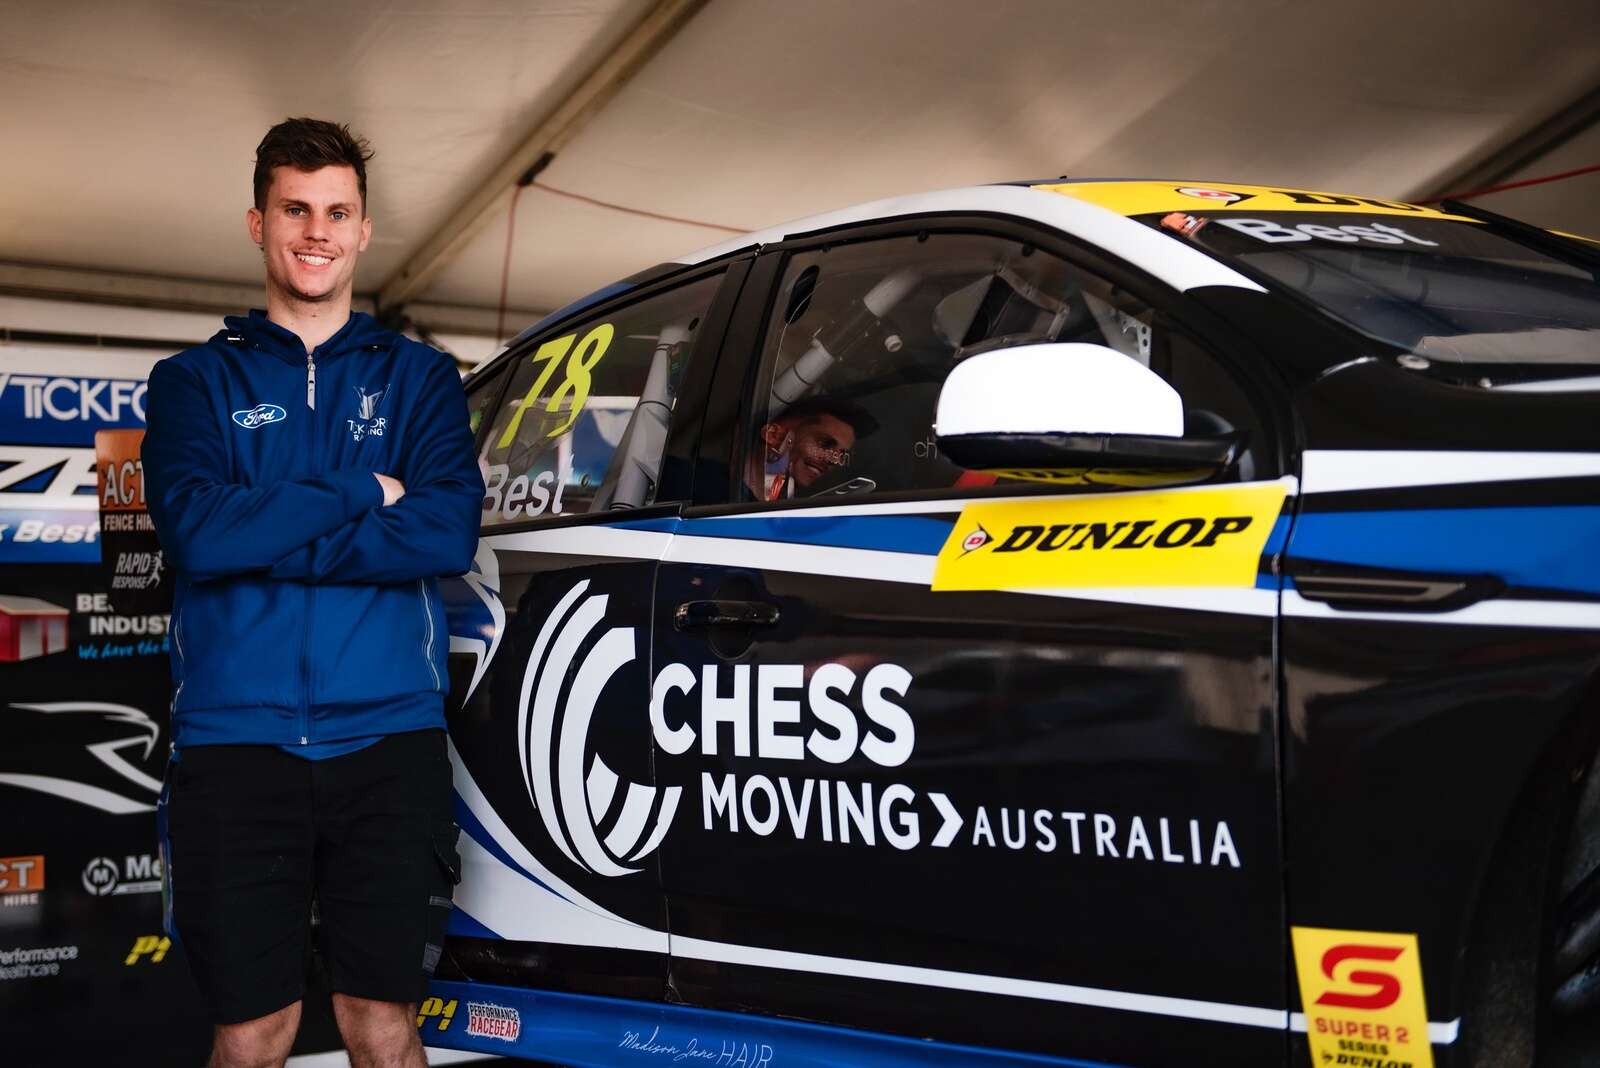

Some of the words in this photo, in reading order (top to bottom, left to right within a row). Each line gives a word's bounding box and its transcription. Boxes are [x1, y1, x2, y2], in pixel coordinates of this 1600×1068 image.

[1215, 219, 1439, 246] Best
[497, 323, 614, 449] 78
[482, 454, 565, 520] Best
[12, 519, 100, 544] Best
[104, 514, 135, 532] FENCE
[992, 516, 1253, 553] DUNLOP
[115, 552, 151, 574] RAPID
[649, 662, 915, 768] CHESS
[701, 772, 920, 851] MOVING
[971, 805, 1241, 868] AUSTRALIA
[4, 893, 38, 907] HIRE
[0, 945, 79, 965] erformance
[0, 962, 60, 981] ealthcare
[469, 1004, 518, 1022] PERFORMANCE
[470, 1015, 518, 1038] RACEGEAR
[1315, 1017, 1391, 1042] SUPER
[1395, 1026, 1409, 1044] 2
[716, 1039, 773, 1068] HAIR
[1338, 1039, 1389, 1056] SERIES
